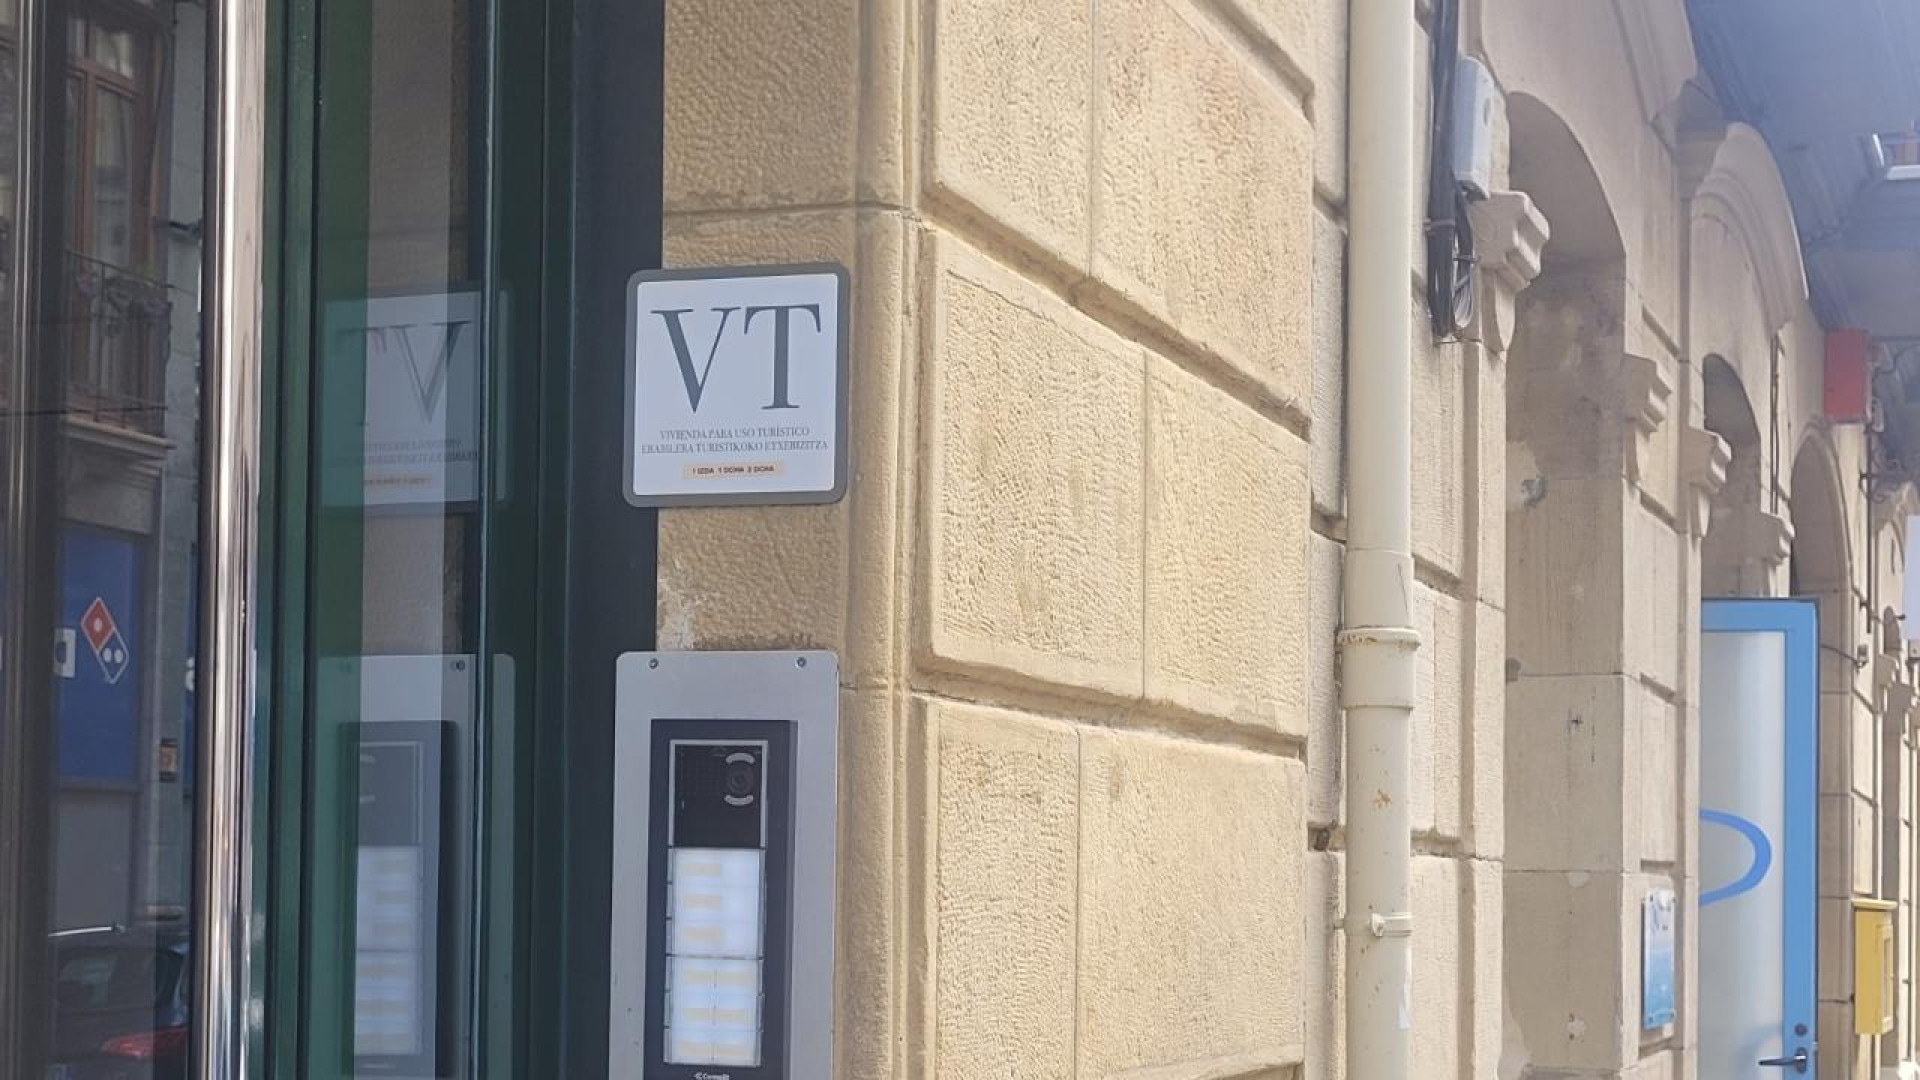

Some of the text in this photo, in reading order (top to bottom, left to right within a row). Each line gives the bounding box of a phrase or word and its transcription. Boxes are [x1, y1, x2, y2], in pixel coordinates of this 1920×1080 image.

[650, 303, 821, 414] VT
[660, 424, 811, 441] VIVIENDA PARA USO TURÍSTICO
[641, 440, 829, 454] ERABILERA TURISTIKOKO ETXEBIZITZA
